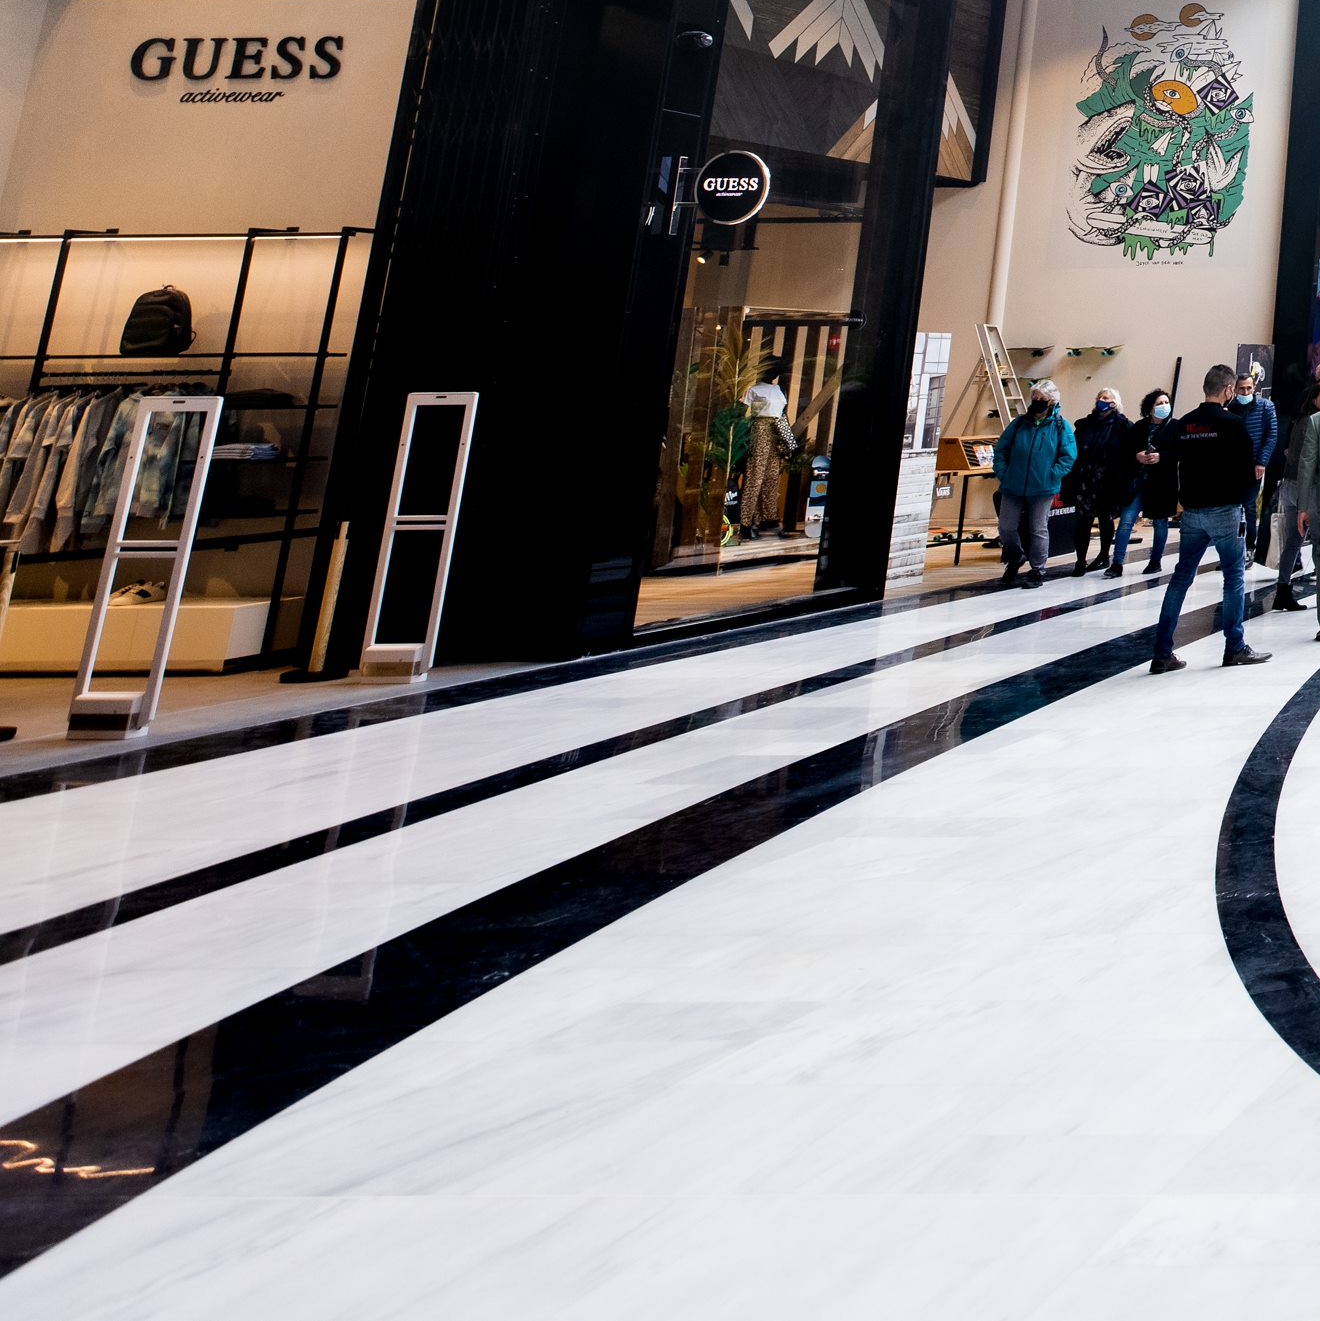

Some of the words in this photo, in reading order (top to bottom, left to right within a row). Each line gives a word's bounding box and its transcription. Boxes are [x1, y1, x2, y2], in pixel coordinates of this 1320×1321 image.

[130, 36, 344, 81] GUESS
[179, 87, 285, 104] activewear
[703, 177, 759, 191] GUESS
